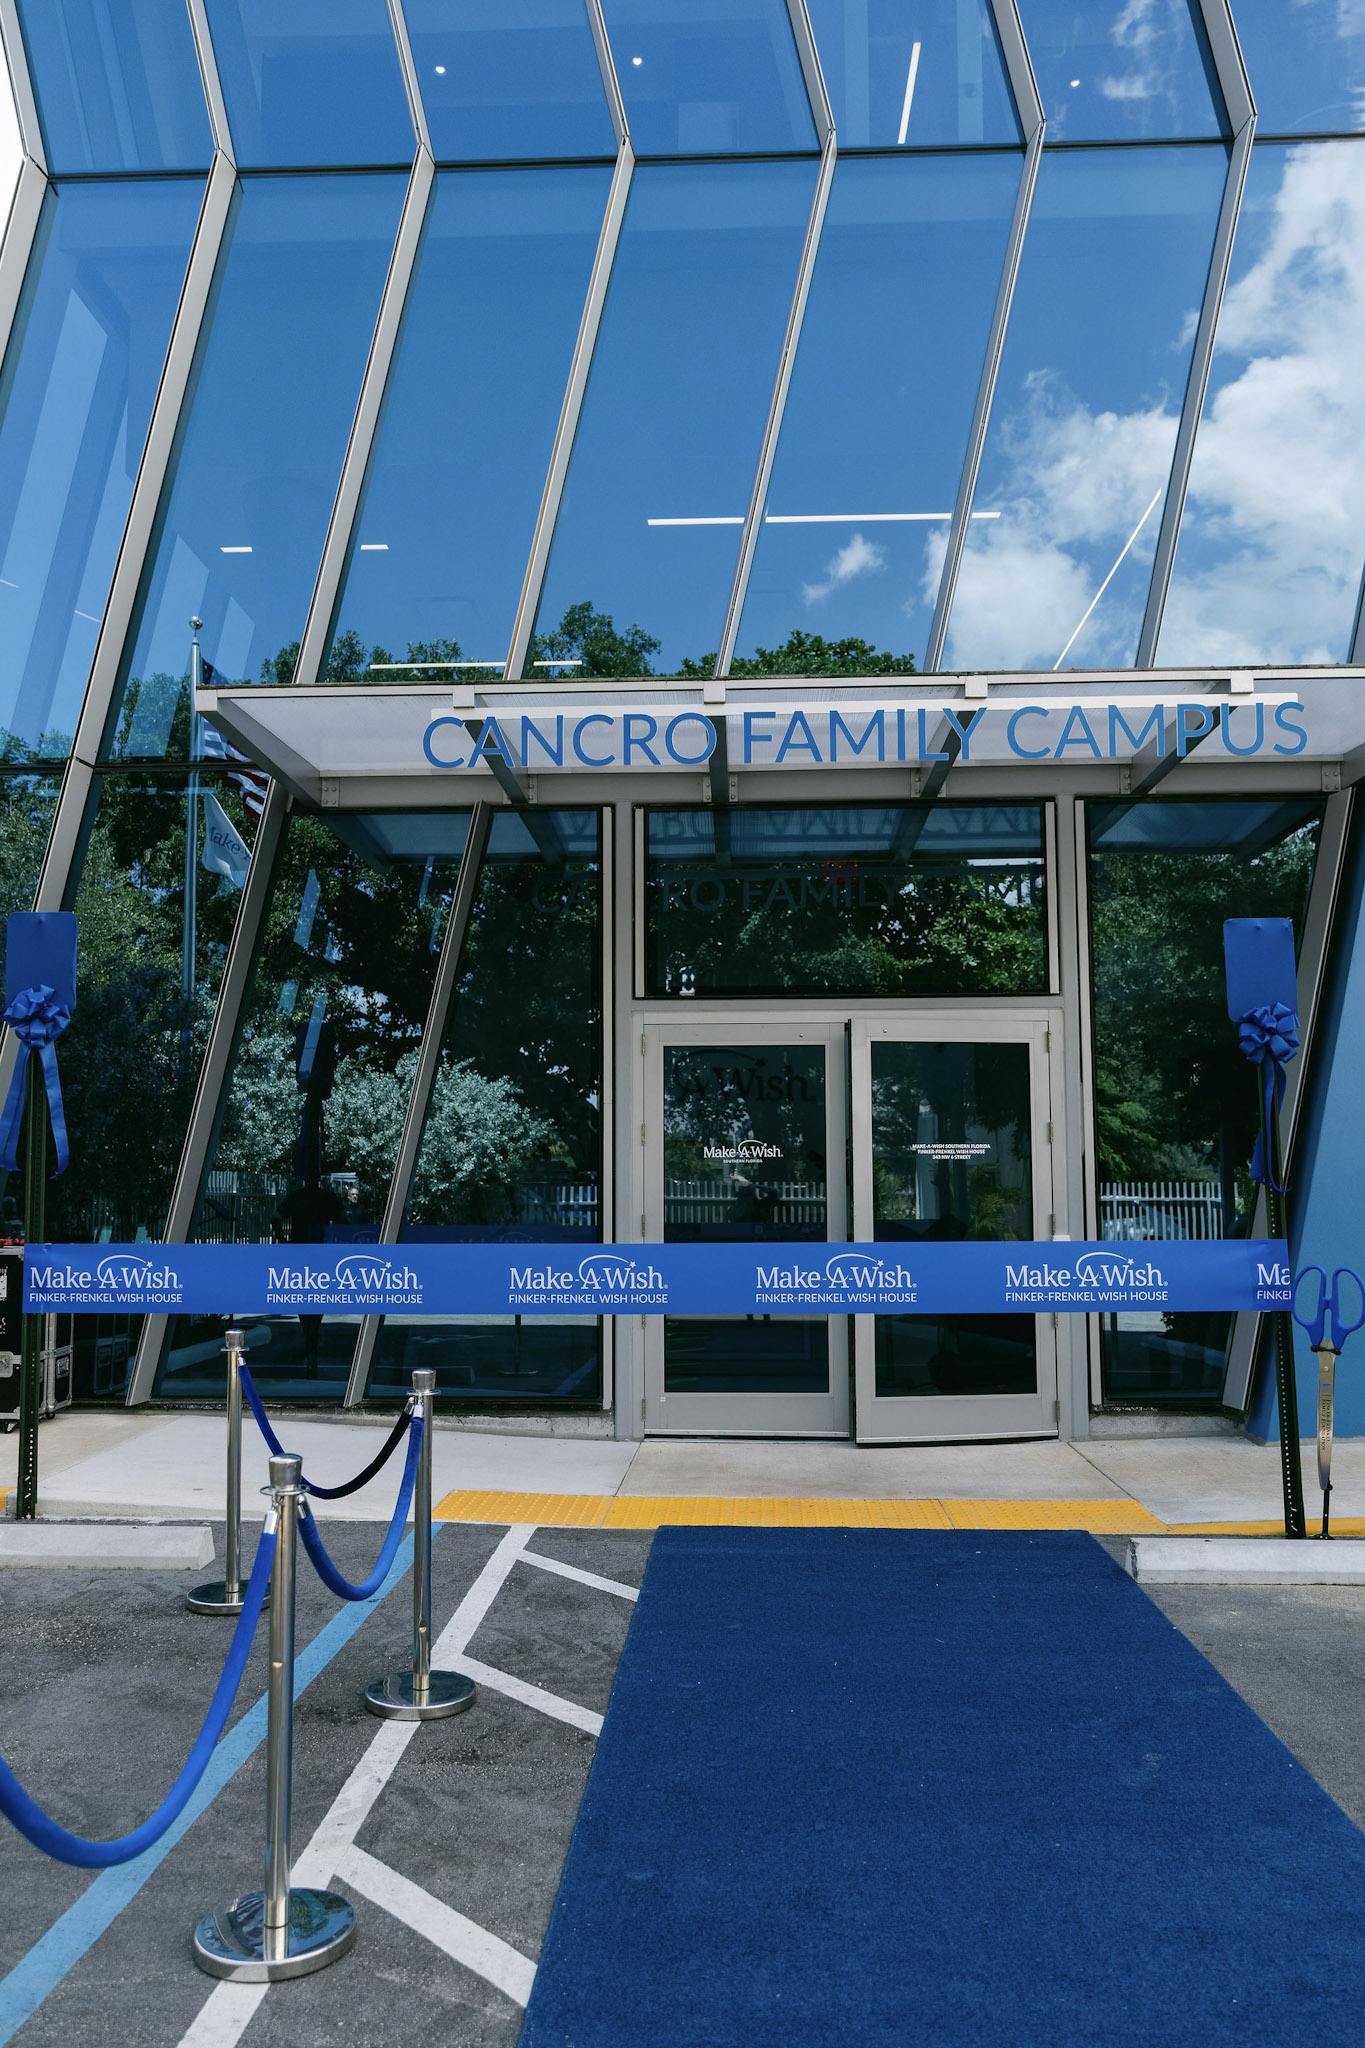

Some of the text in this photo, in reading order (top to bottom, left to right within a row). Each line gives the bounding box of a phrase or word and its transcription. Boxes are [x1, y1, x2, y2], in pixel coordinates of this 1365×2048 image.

[422, 701, 1308, 769] CANCRO FAMILY CAMPUS
[530, 874, 726, 913] CARO
[29, 1292, 183, 1303] FINKER-FRENKEL WISH HOUSE
[266, 1293, 423, 1304] FINKER-FRENKEL WISH HOUSE
[508, 1294, 668, 1304] FINKER-FRENKEL WISH HOUSE
[755, 1292, 917, 1303] FINKER-FRENKEL WISH HOUSE
[1005, 1291, 1168, 1302] FINKER-FRENKEL WISH HOUSE
